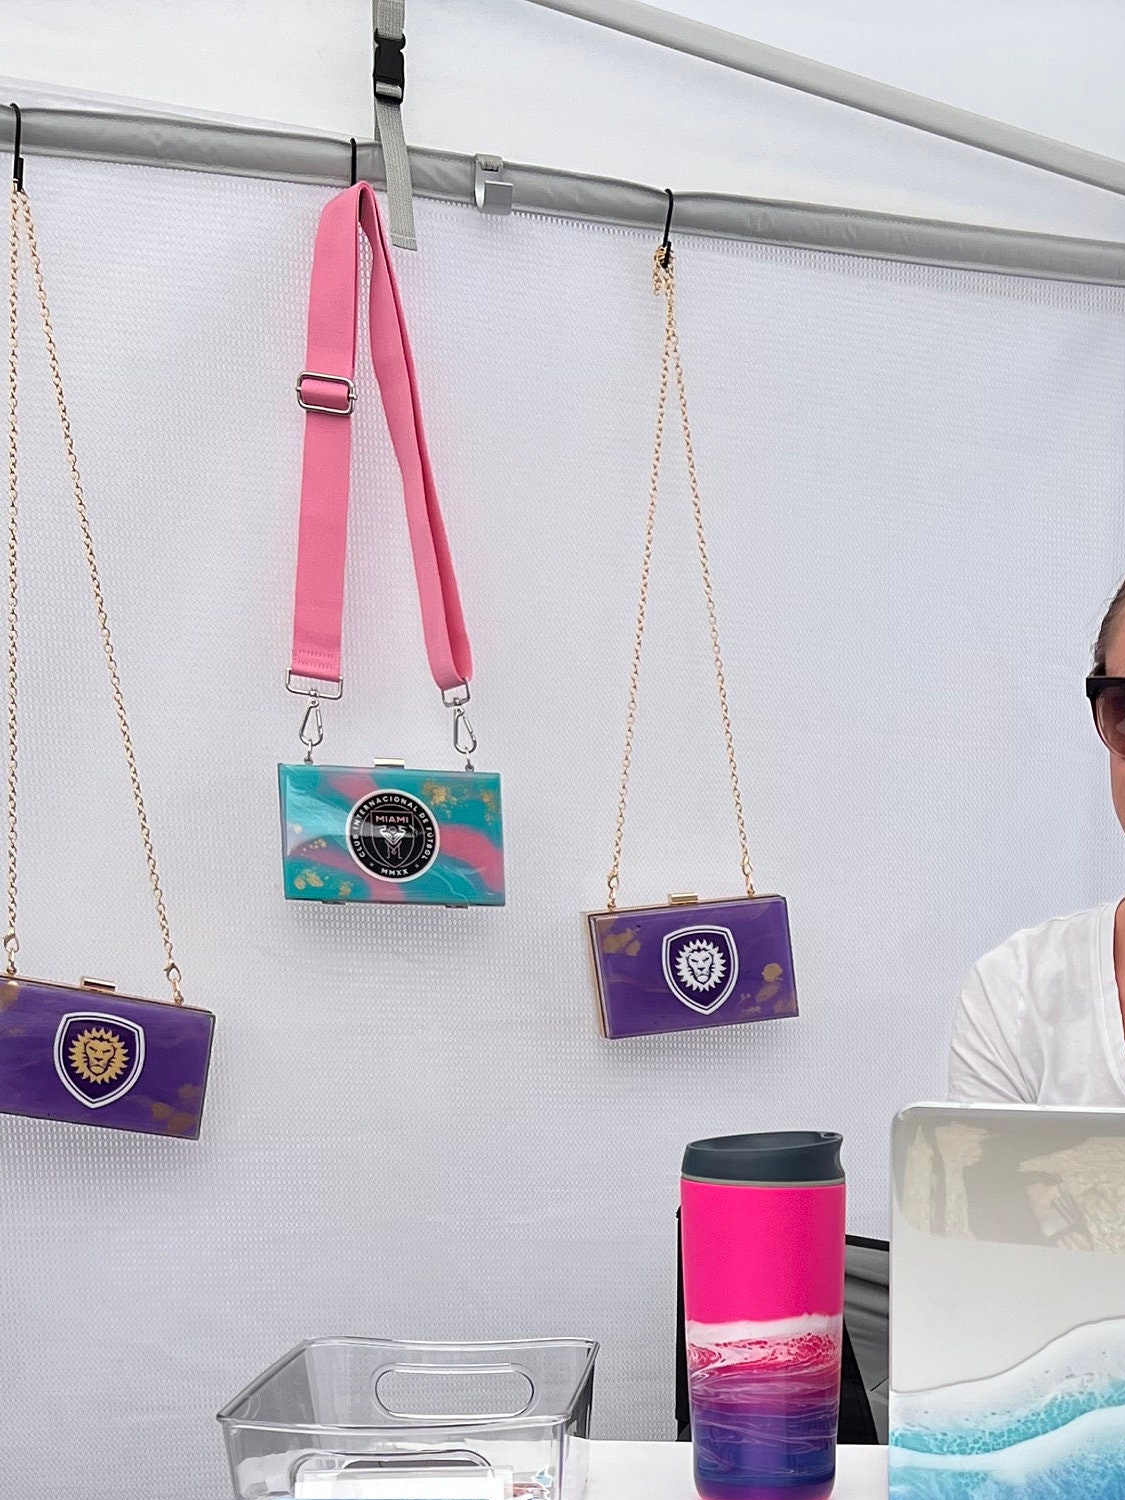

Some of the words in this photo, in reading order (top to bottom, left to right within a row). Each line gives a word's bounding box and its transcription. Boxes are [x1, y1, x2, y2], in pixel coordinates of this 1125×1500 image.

[353, 796, 418, 830] INTERNACIONAL
[418, 812, 429, 824] DE
[375, 815, 409, 824] MIAMI
[352, 834, 366, 858] CLUB
[381, 867, 409, 876] MMXX
